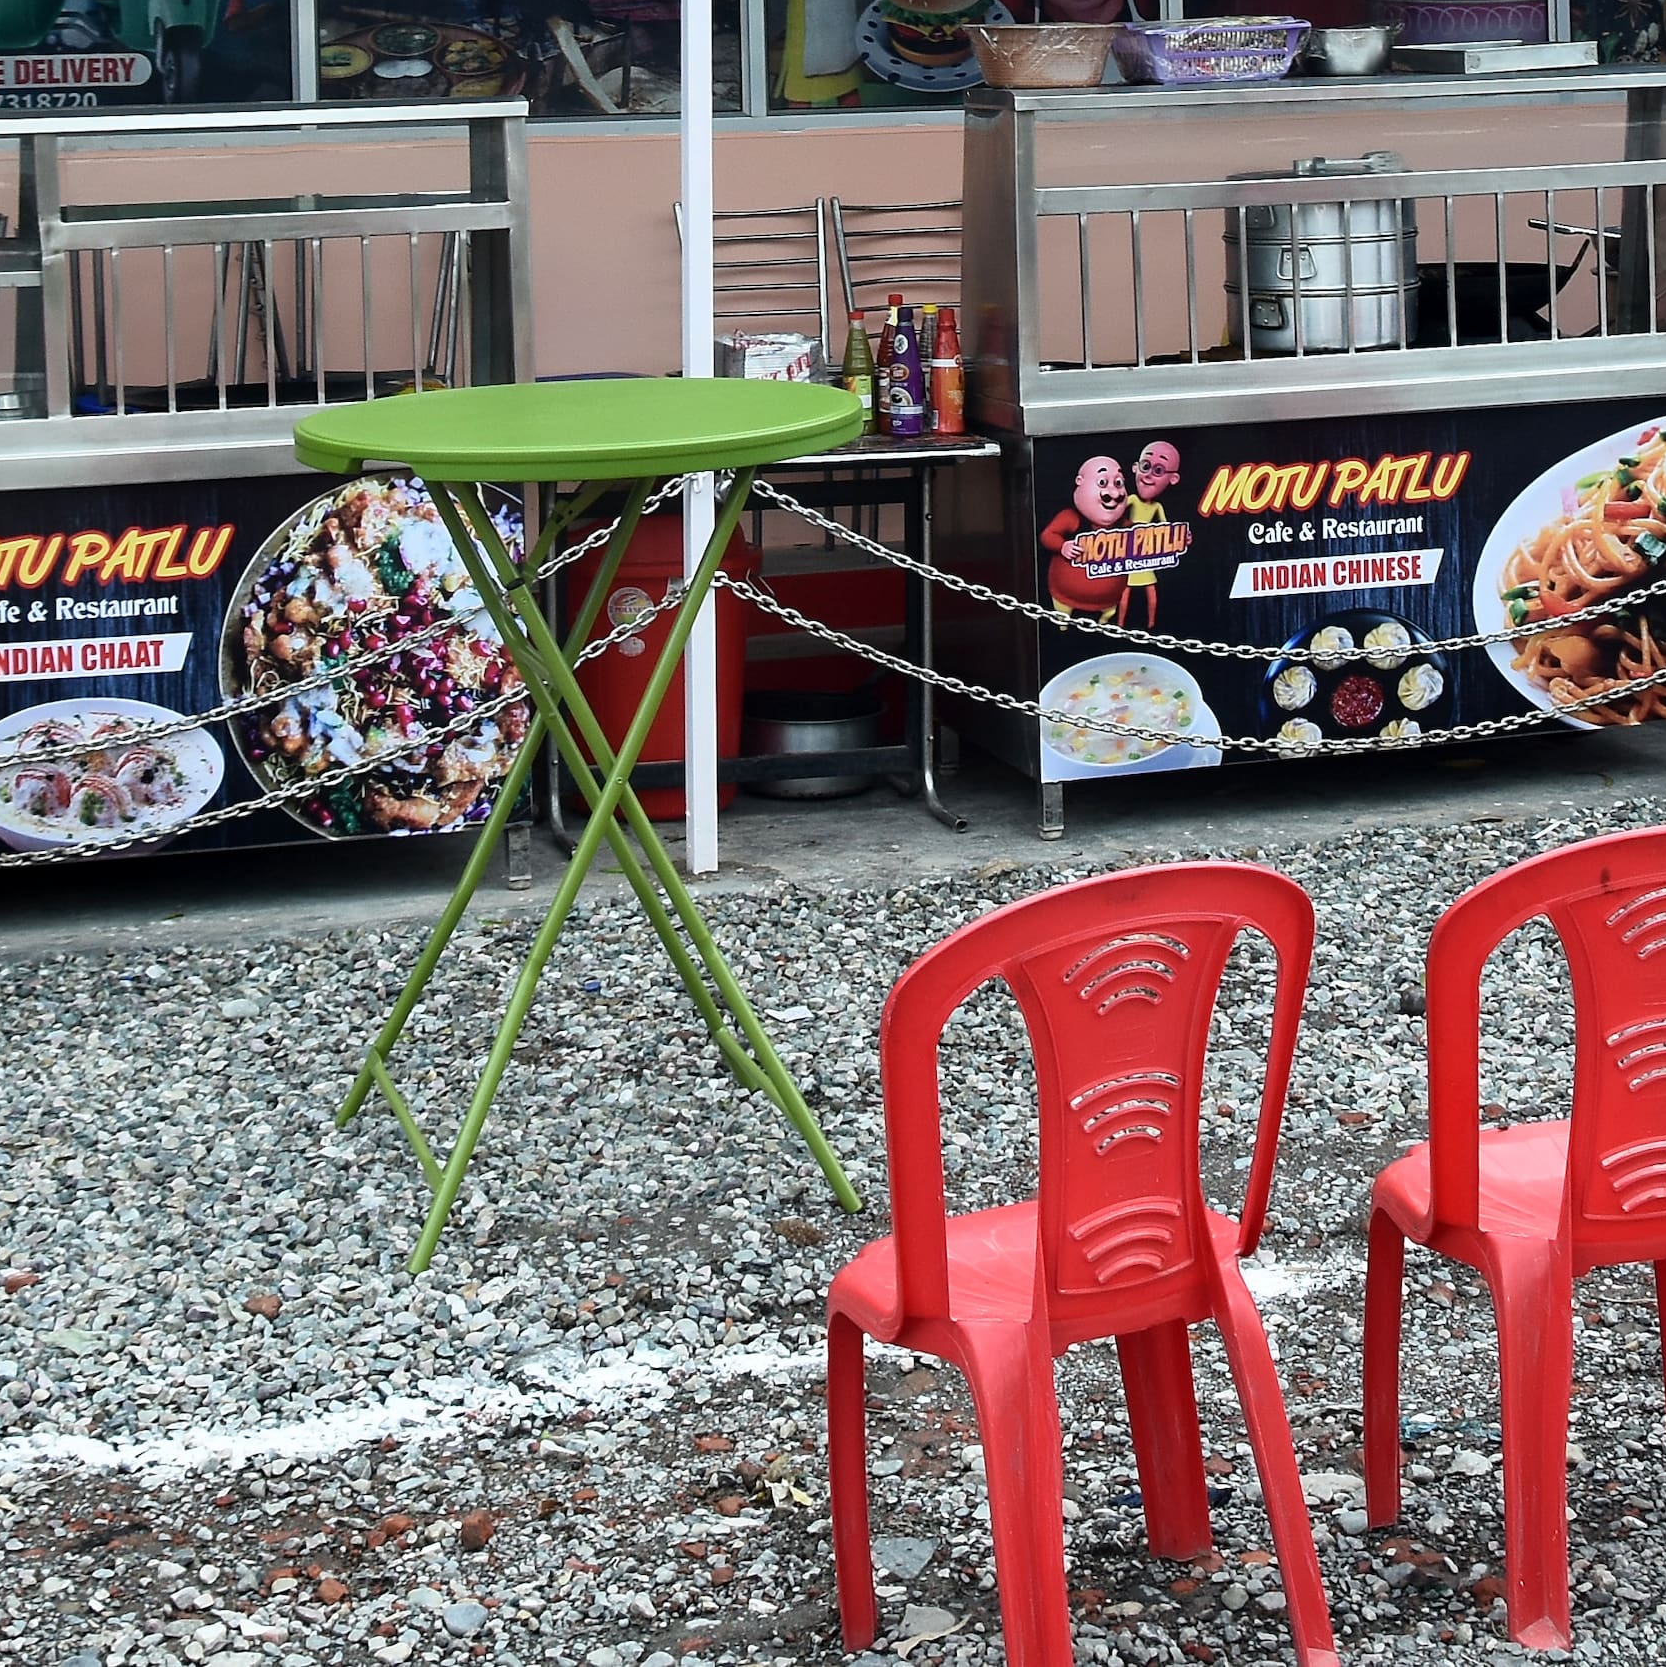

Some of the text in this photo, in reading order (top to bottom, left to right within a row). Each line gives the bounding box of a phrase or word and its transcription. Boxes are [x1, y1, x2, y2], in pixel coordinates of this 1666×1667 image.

[14, 56, 136, 85] DELIVERY
[1198, 451, 1471, 518] MOTU PATLU
[1076, 524, 1186, 564] MOTU PATLU
[1248, 515, 1424, 545] Cafe & Restaurant
[62, 524, 235, 586] PATLU
[1089, 554, 1175, 575] Cafe & Restaurant
[1252, 555, 1422, 592] INDIAN CHINESE
[27, 600, 49, 623] &
[55, 595, 178, 621] Restaurant
[80, 640, 164, 671] CHAAT
